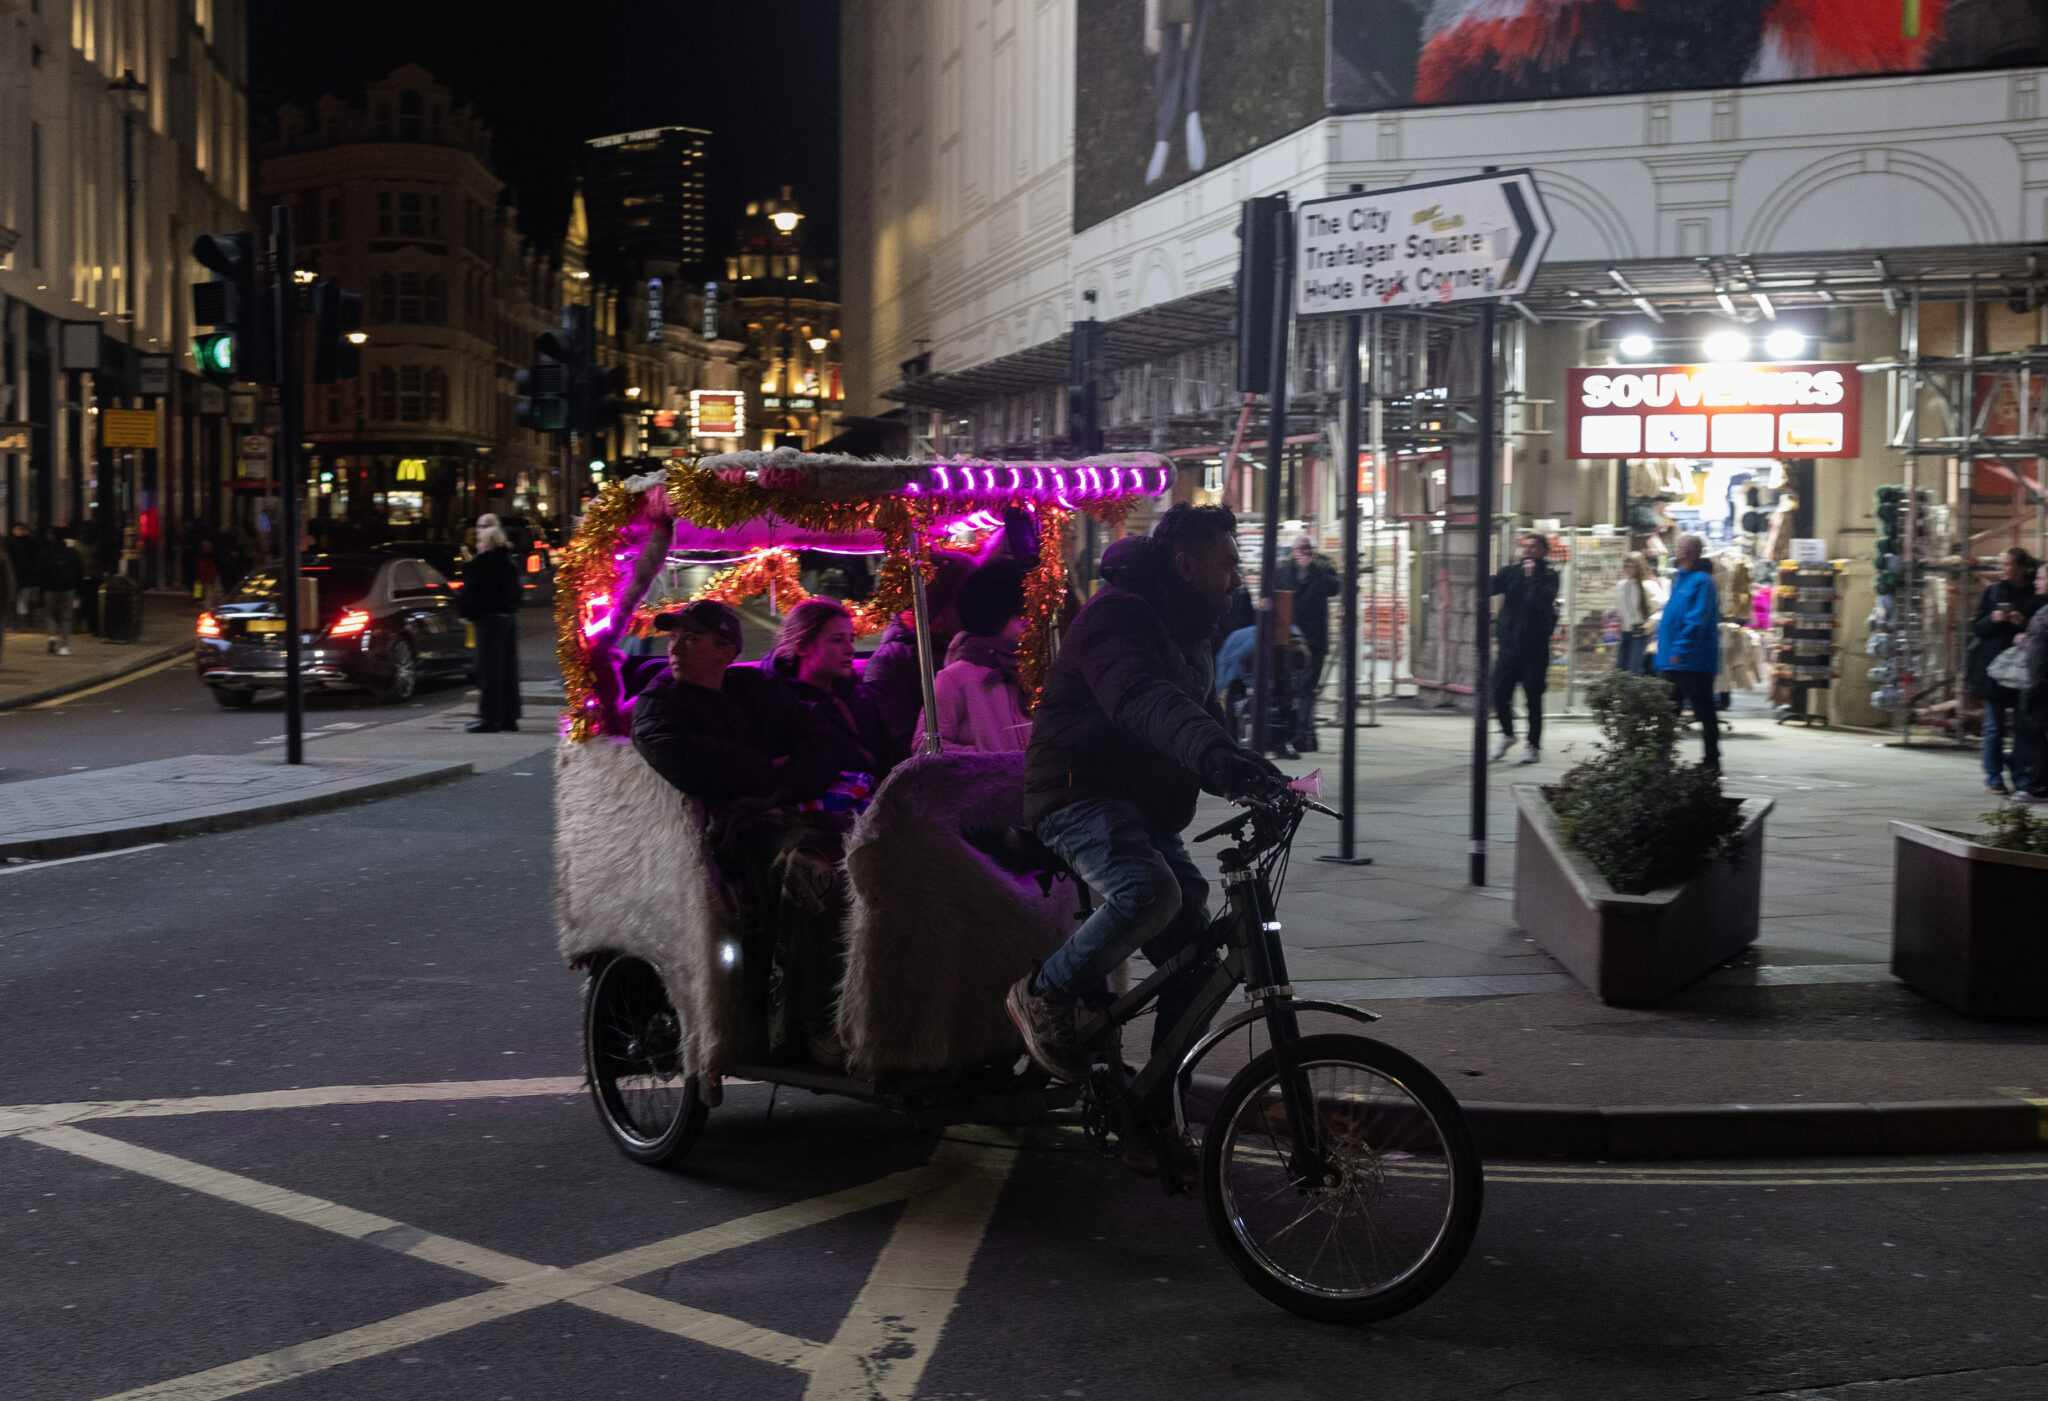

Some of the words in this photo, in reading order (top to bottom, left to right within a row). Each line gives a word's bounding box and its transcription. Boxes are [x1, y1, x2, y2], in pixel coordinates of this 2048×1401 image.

[1306, 212, 1342, 237] The
[1347, 206, 1391, 233] City
[1305, 242, 1396, 270] Trafalgar
[1405, 233, 1481, 260] Square
[1303, 277, 1353, 303] Hyde
[1361, 270, 1408, 298] Park
